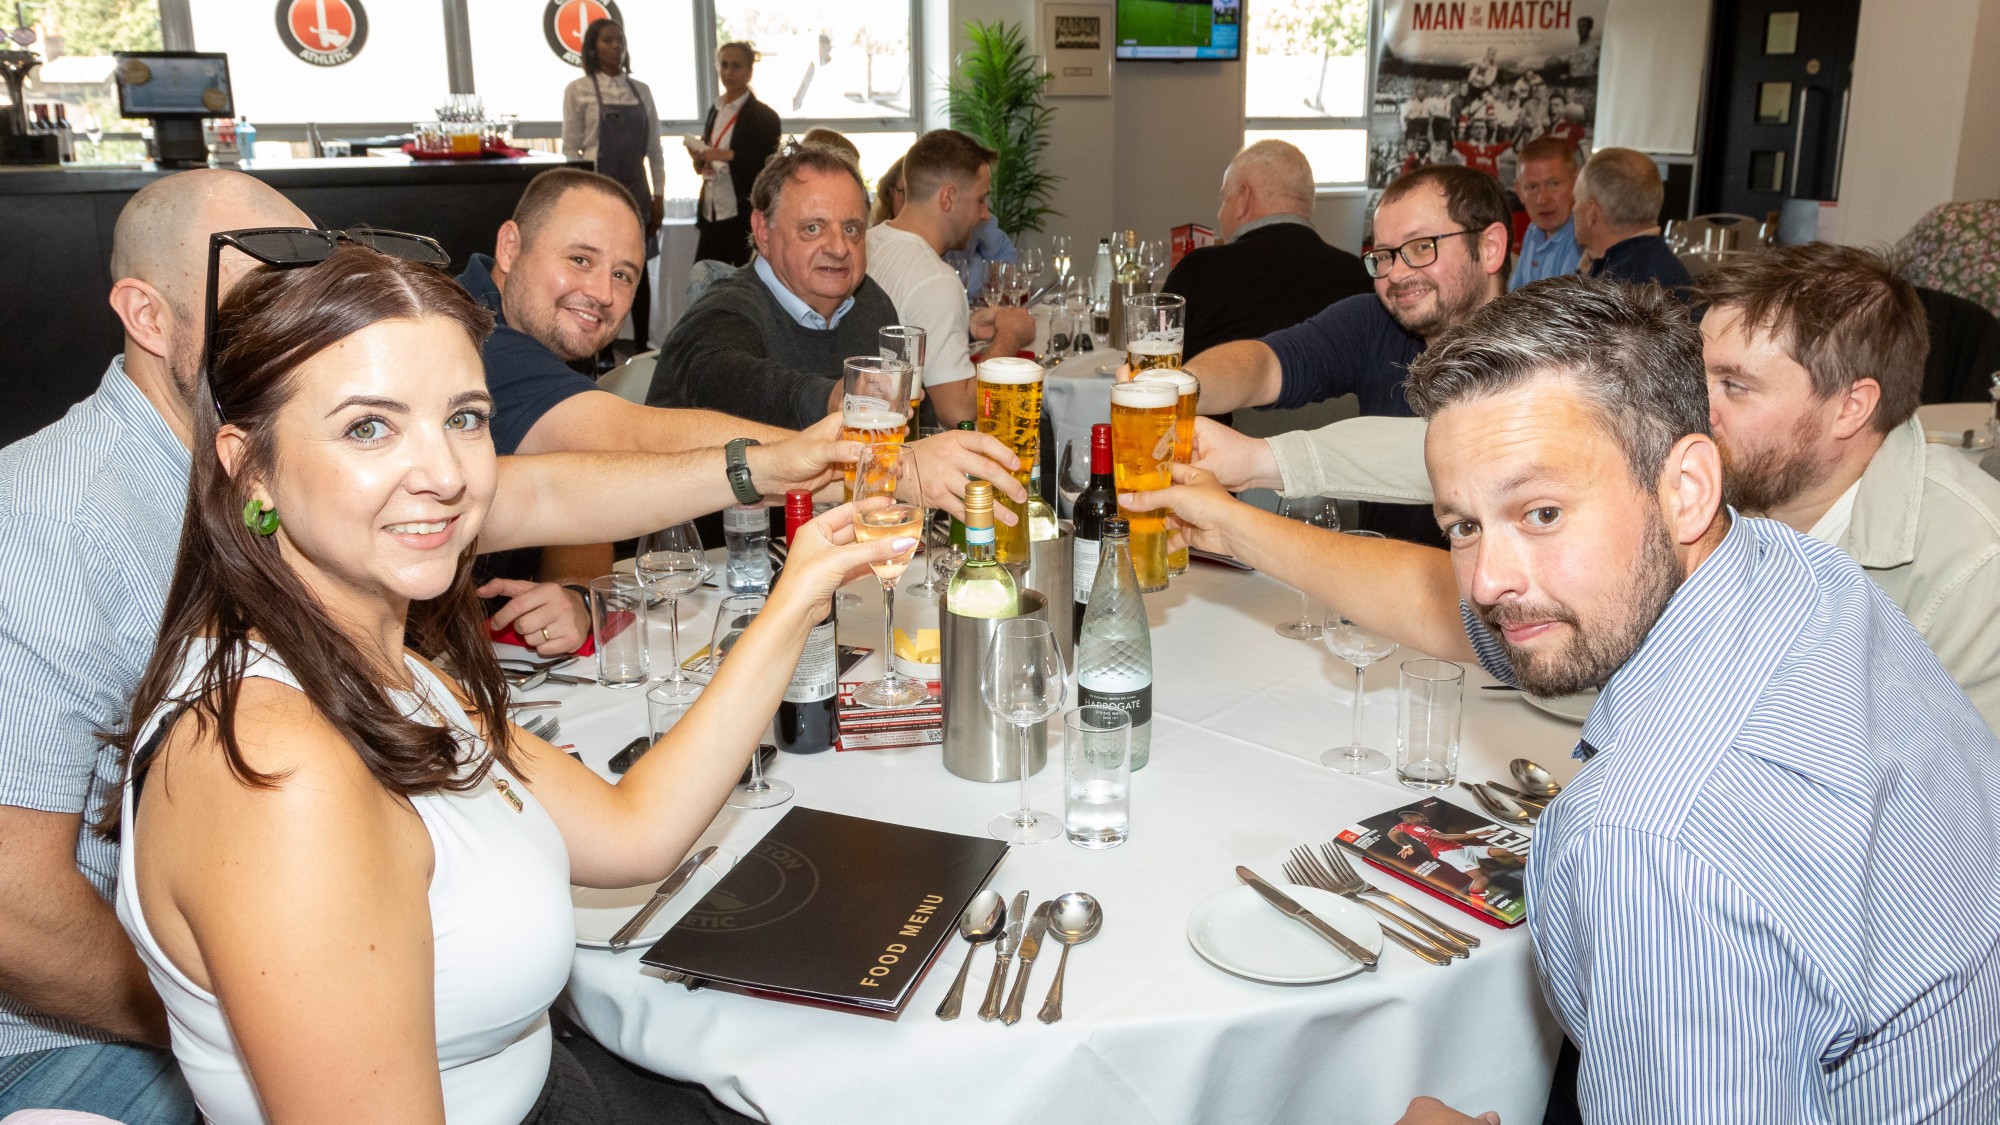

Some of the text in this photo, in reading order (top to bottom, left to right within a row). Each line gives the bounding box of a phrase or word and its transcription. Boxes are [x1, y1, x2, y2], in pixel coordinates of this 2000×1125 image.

[1412, 0, 1571, 30] MAN OF THE MATCH
[299, 47, 353, 65] ATHLETIC
[860, 894, 944, 987] FOOD MENU
